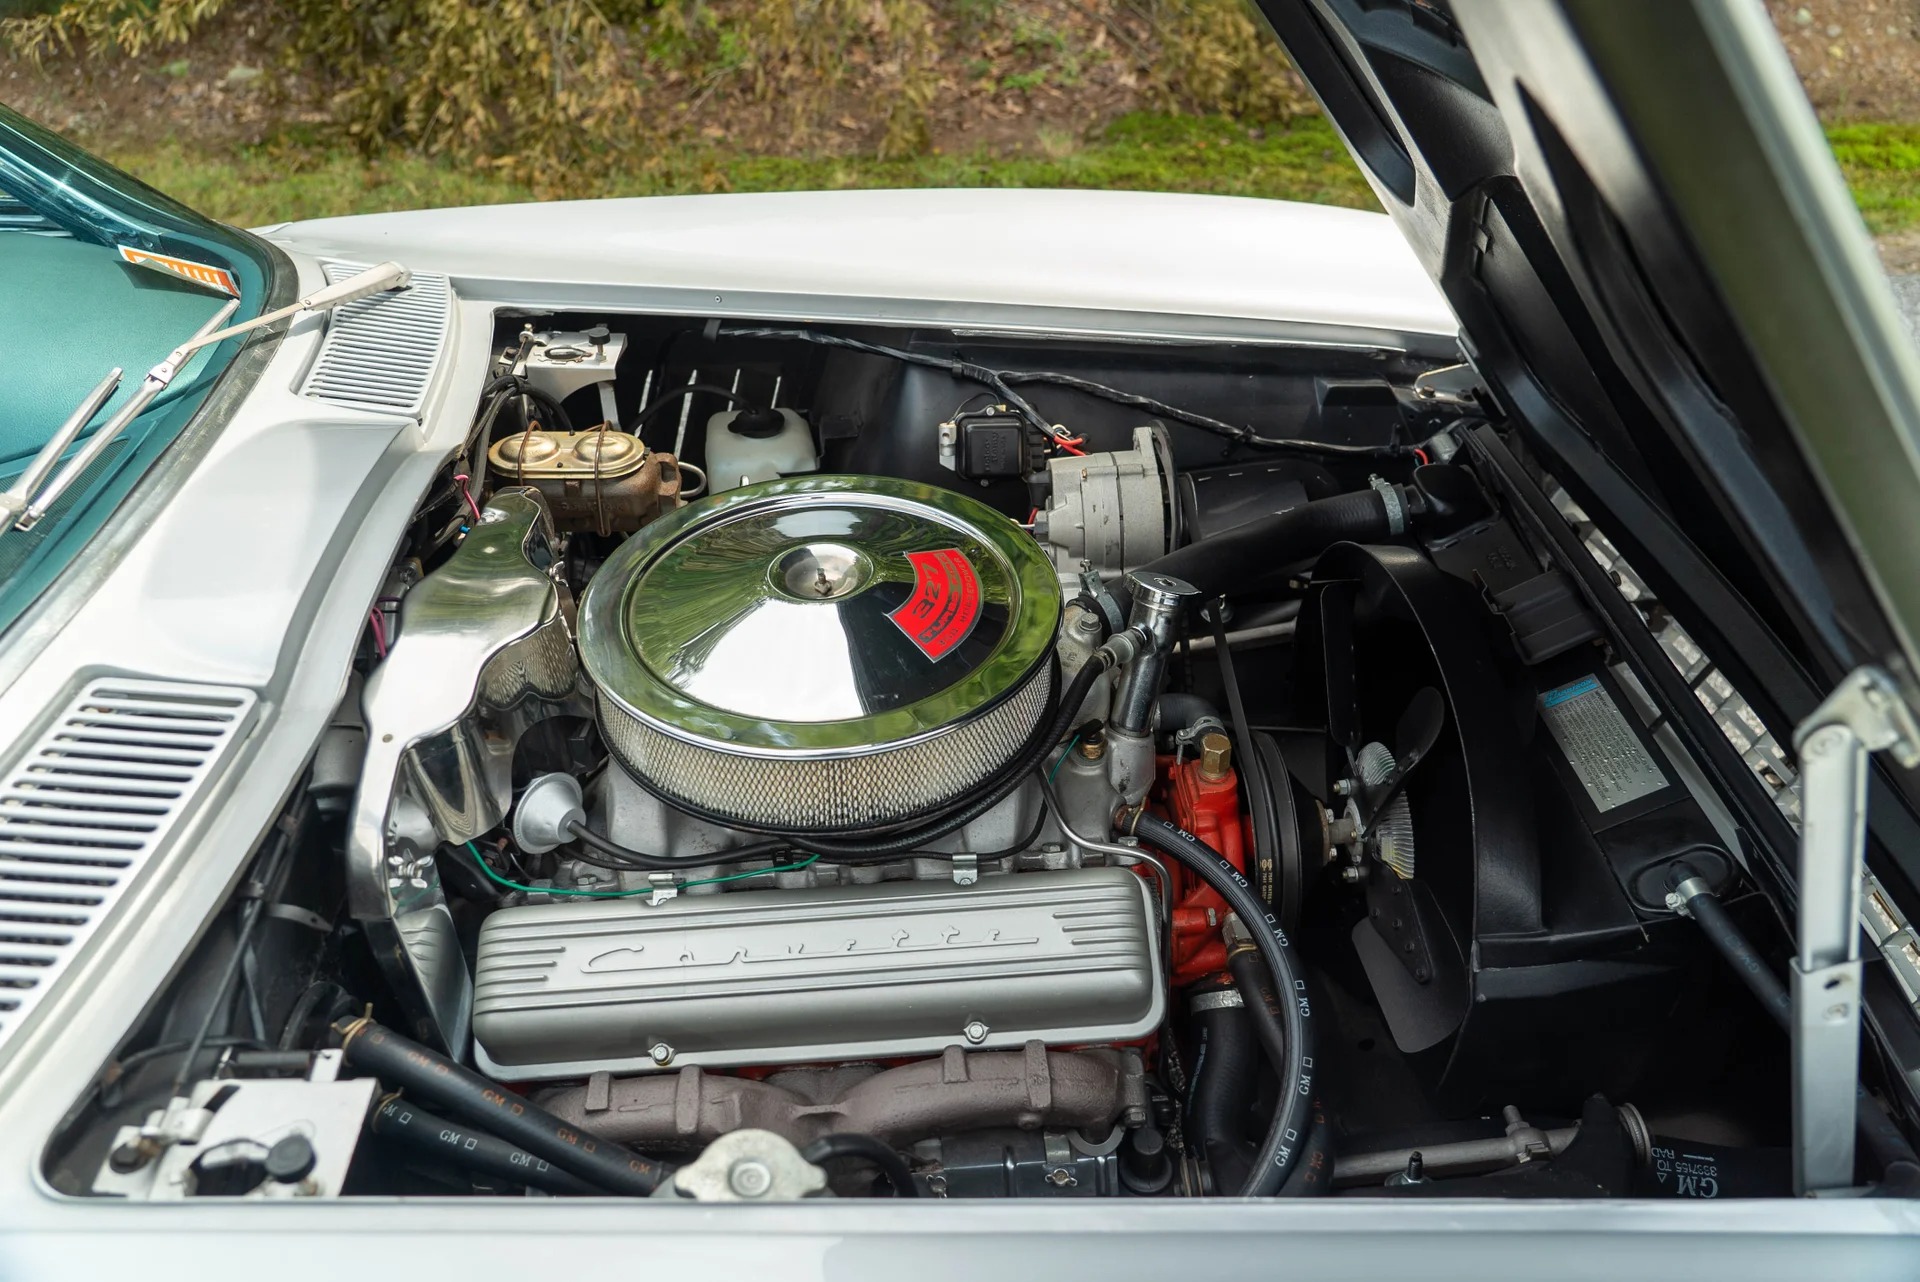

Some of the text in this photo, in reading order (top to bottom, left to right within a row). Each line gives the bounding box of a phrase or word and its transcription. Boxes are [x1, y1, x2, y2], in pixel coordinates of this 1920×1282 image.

[912, 562, 941, 619] 327
[1178, 829, 1196, 842] GM
[1231, 871, 1248, 888] GM
[1273, 928, 1289, 947] GM
[1298, 997, 1310, 1017] GM
[407, 1050, 432, 1068] GM
[1298, 1074, 1311, 1095] GM
[481, 1089, 506, 1108] GM
[383, 1102, 399, 1118] M
[439, 1129, 462, 1146] GM
[557, 1128, 579, 1145] GM
[510, 1151, 533, 1167] GM
[1274, 1145, 1291, 1167] GM
[1651, 1147, 1675, 1160] RAD
[629, 1160, 651, 1175] GM
[1676, 1174, 1719, 1199] GM
